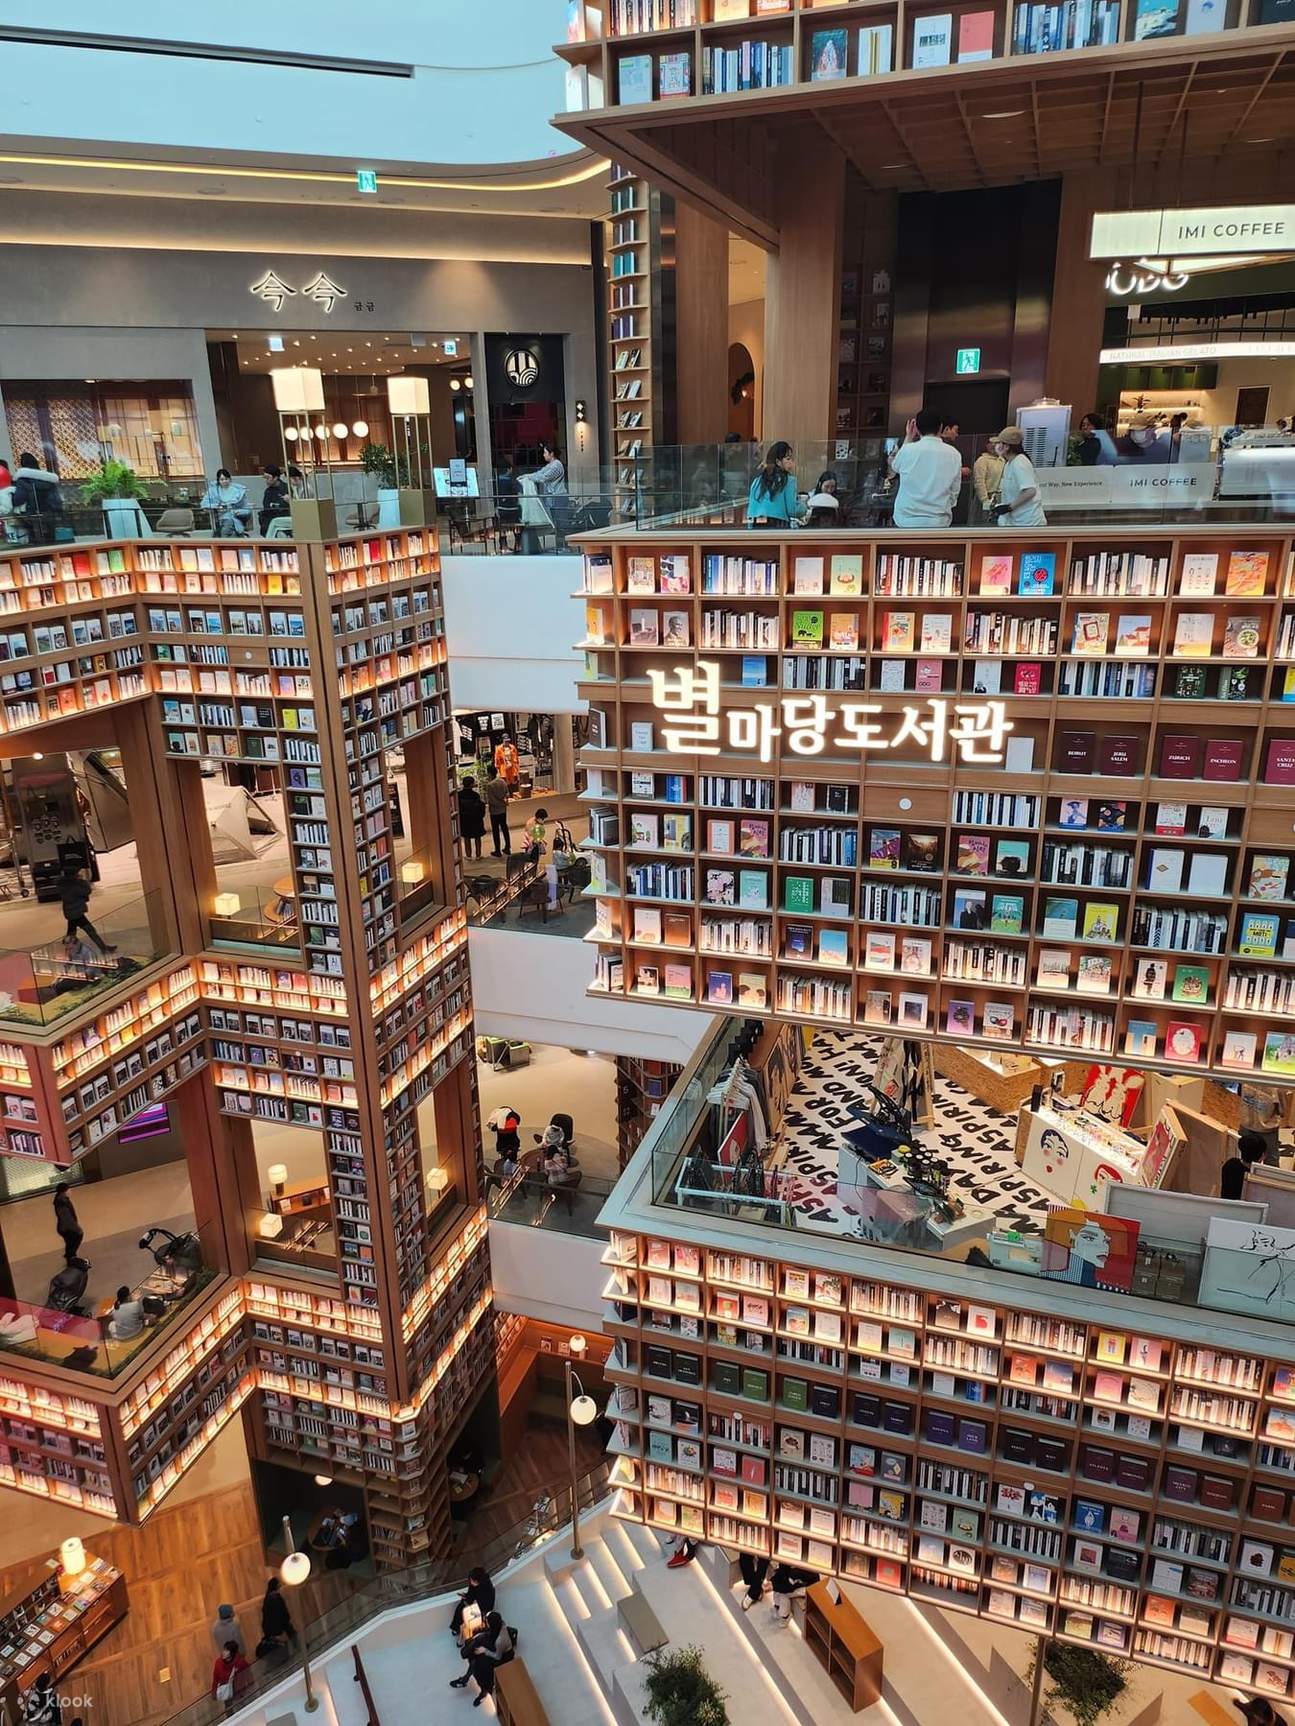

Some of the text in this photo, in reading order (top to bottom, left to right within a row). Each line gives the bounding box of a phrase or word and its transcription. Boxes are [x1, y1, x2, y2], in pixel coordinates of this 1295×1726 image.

[1178, 221, 1285, 239] IMI COFFEE
[250, 270, 347, 312] 今今
[1130, 477, 1198, 488] IMI COFFEE
[646, 660, 1014, 763] 별마당도서관
[804, 1096, 852, 1129] FOR
[821, 1081, 871, 1112] AND
